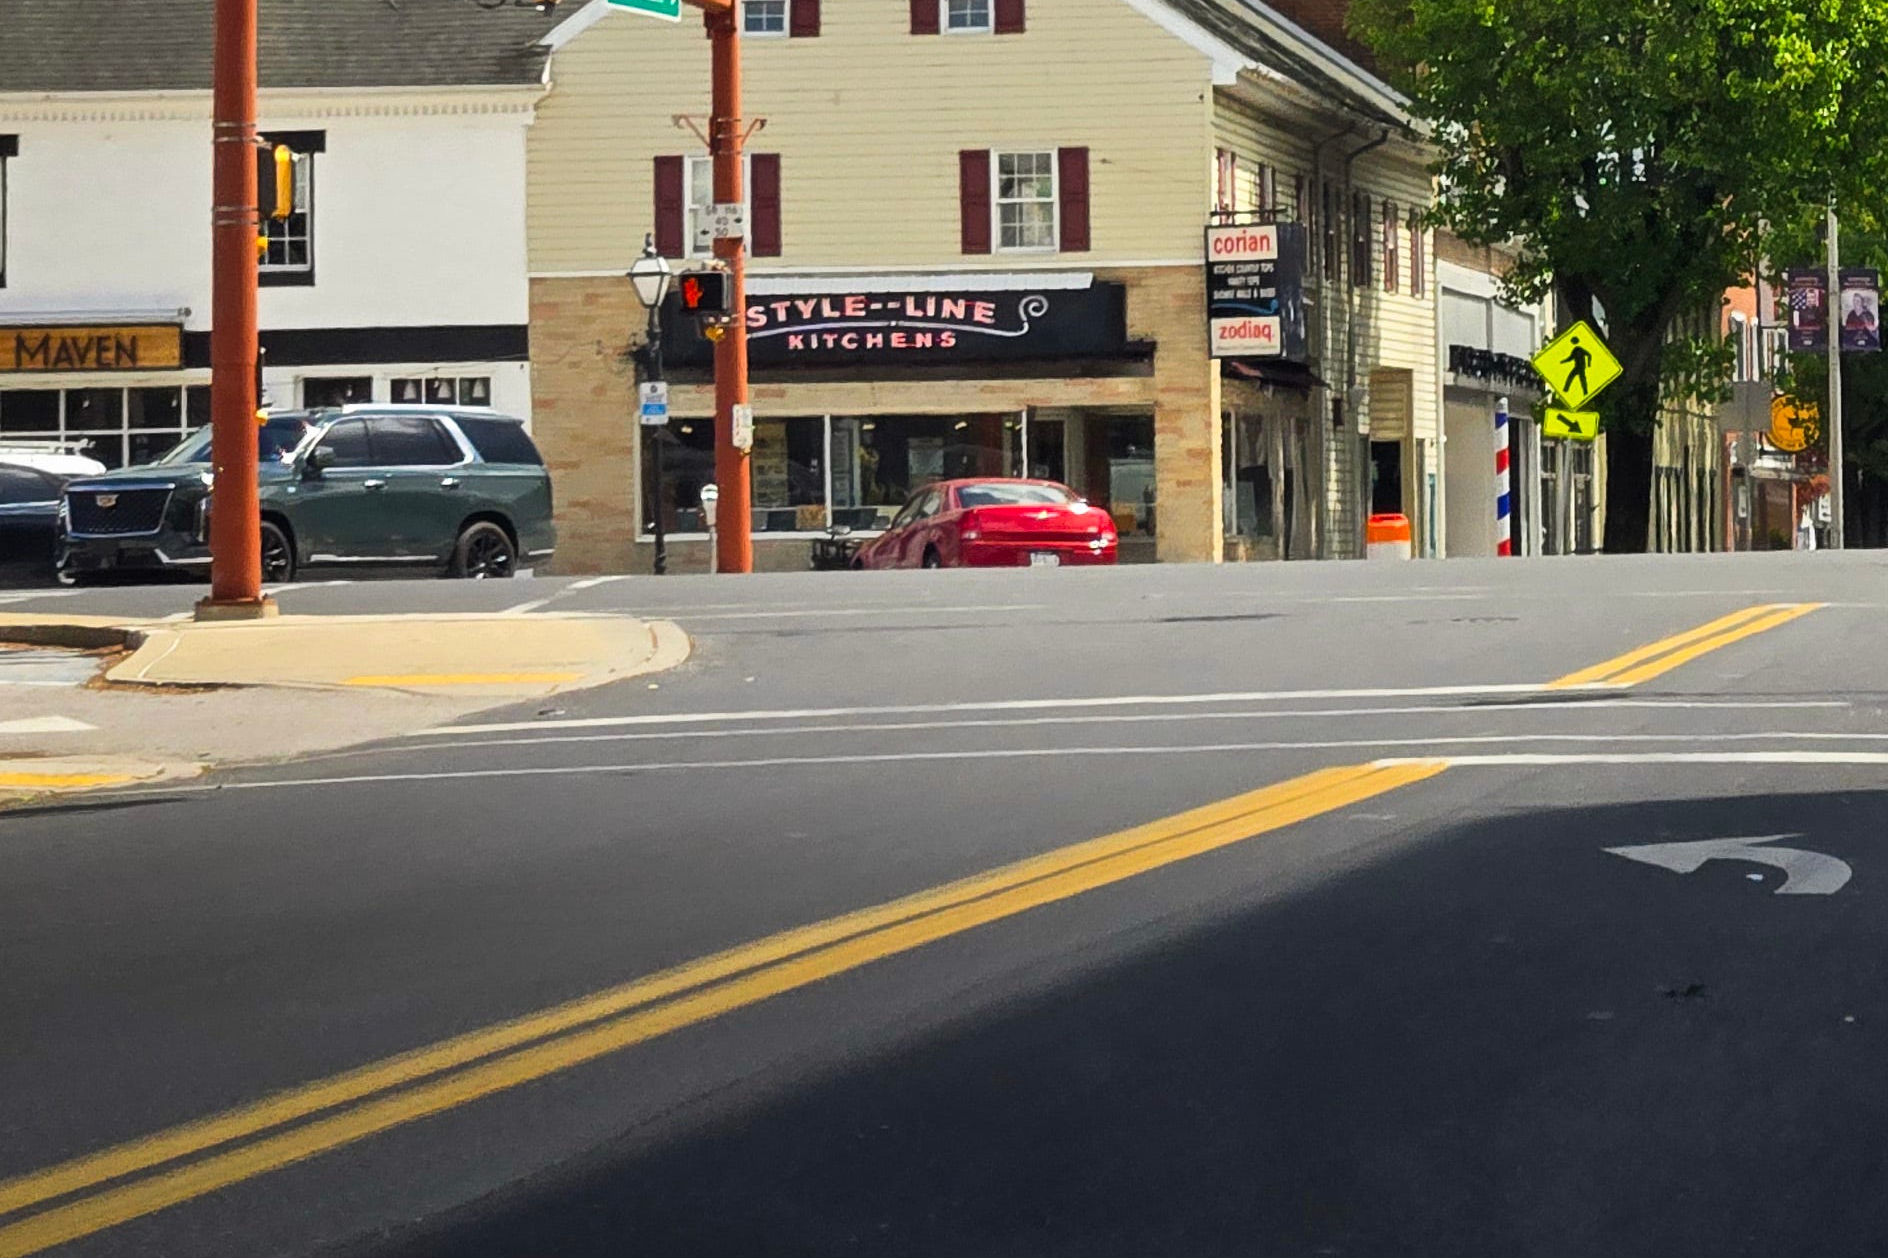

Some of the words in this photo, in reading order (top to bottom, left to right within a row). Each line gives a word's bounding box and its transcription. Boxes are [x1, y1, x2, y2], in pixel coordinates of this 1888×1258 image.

[1213, 229, 1271, 254] corian
[787, 332, 957, 350] KITCHENS
[1218, 320, 1272, 343] zodiaq
[15, 332, 139, 368] MAVEN
